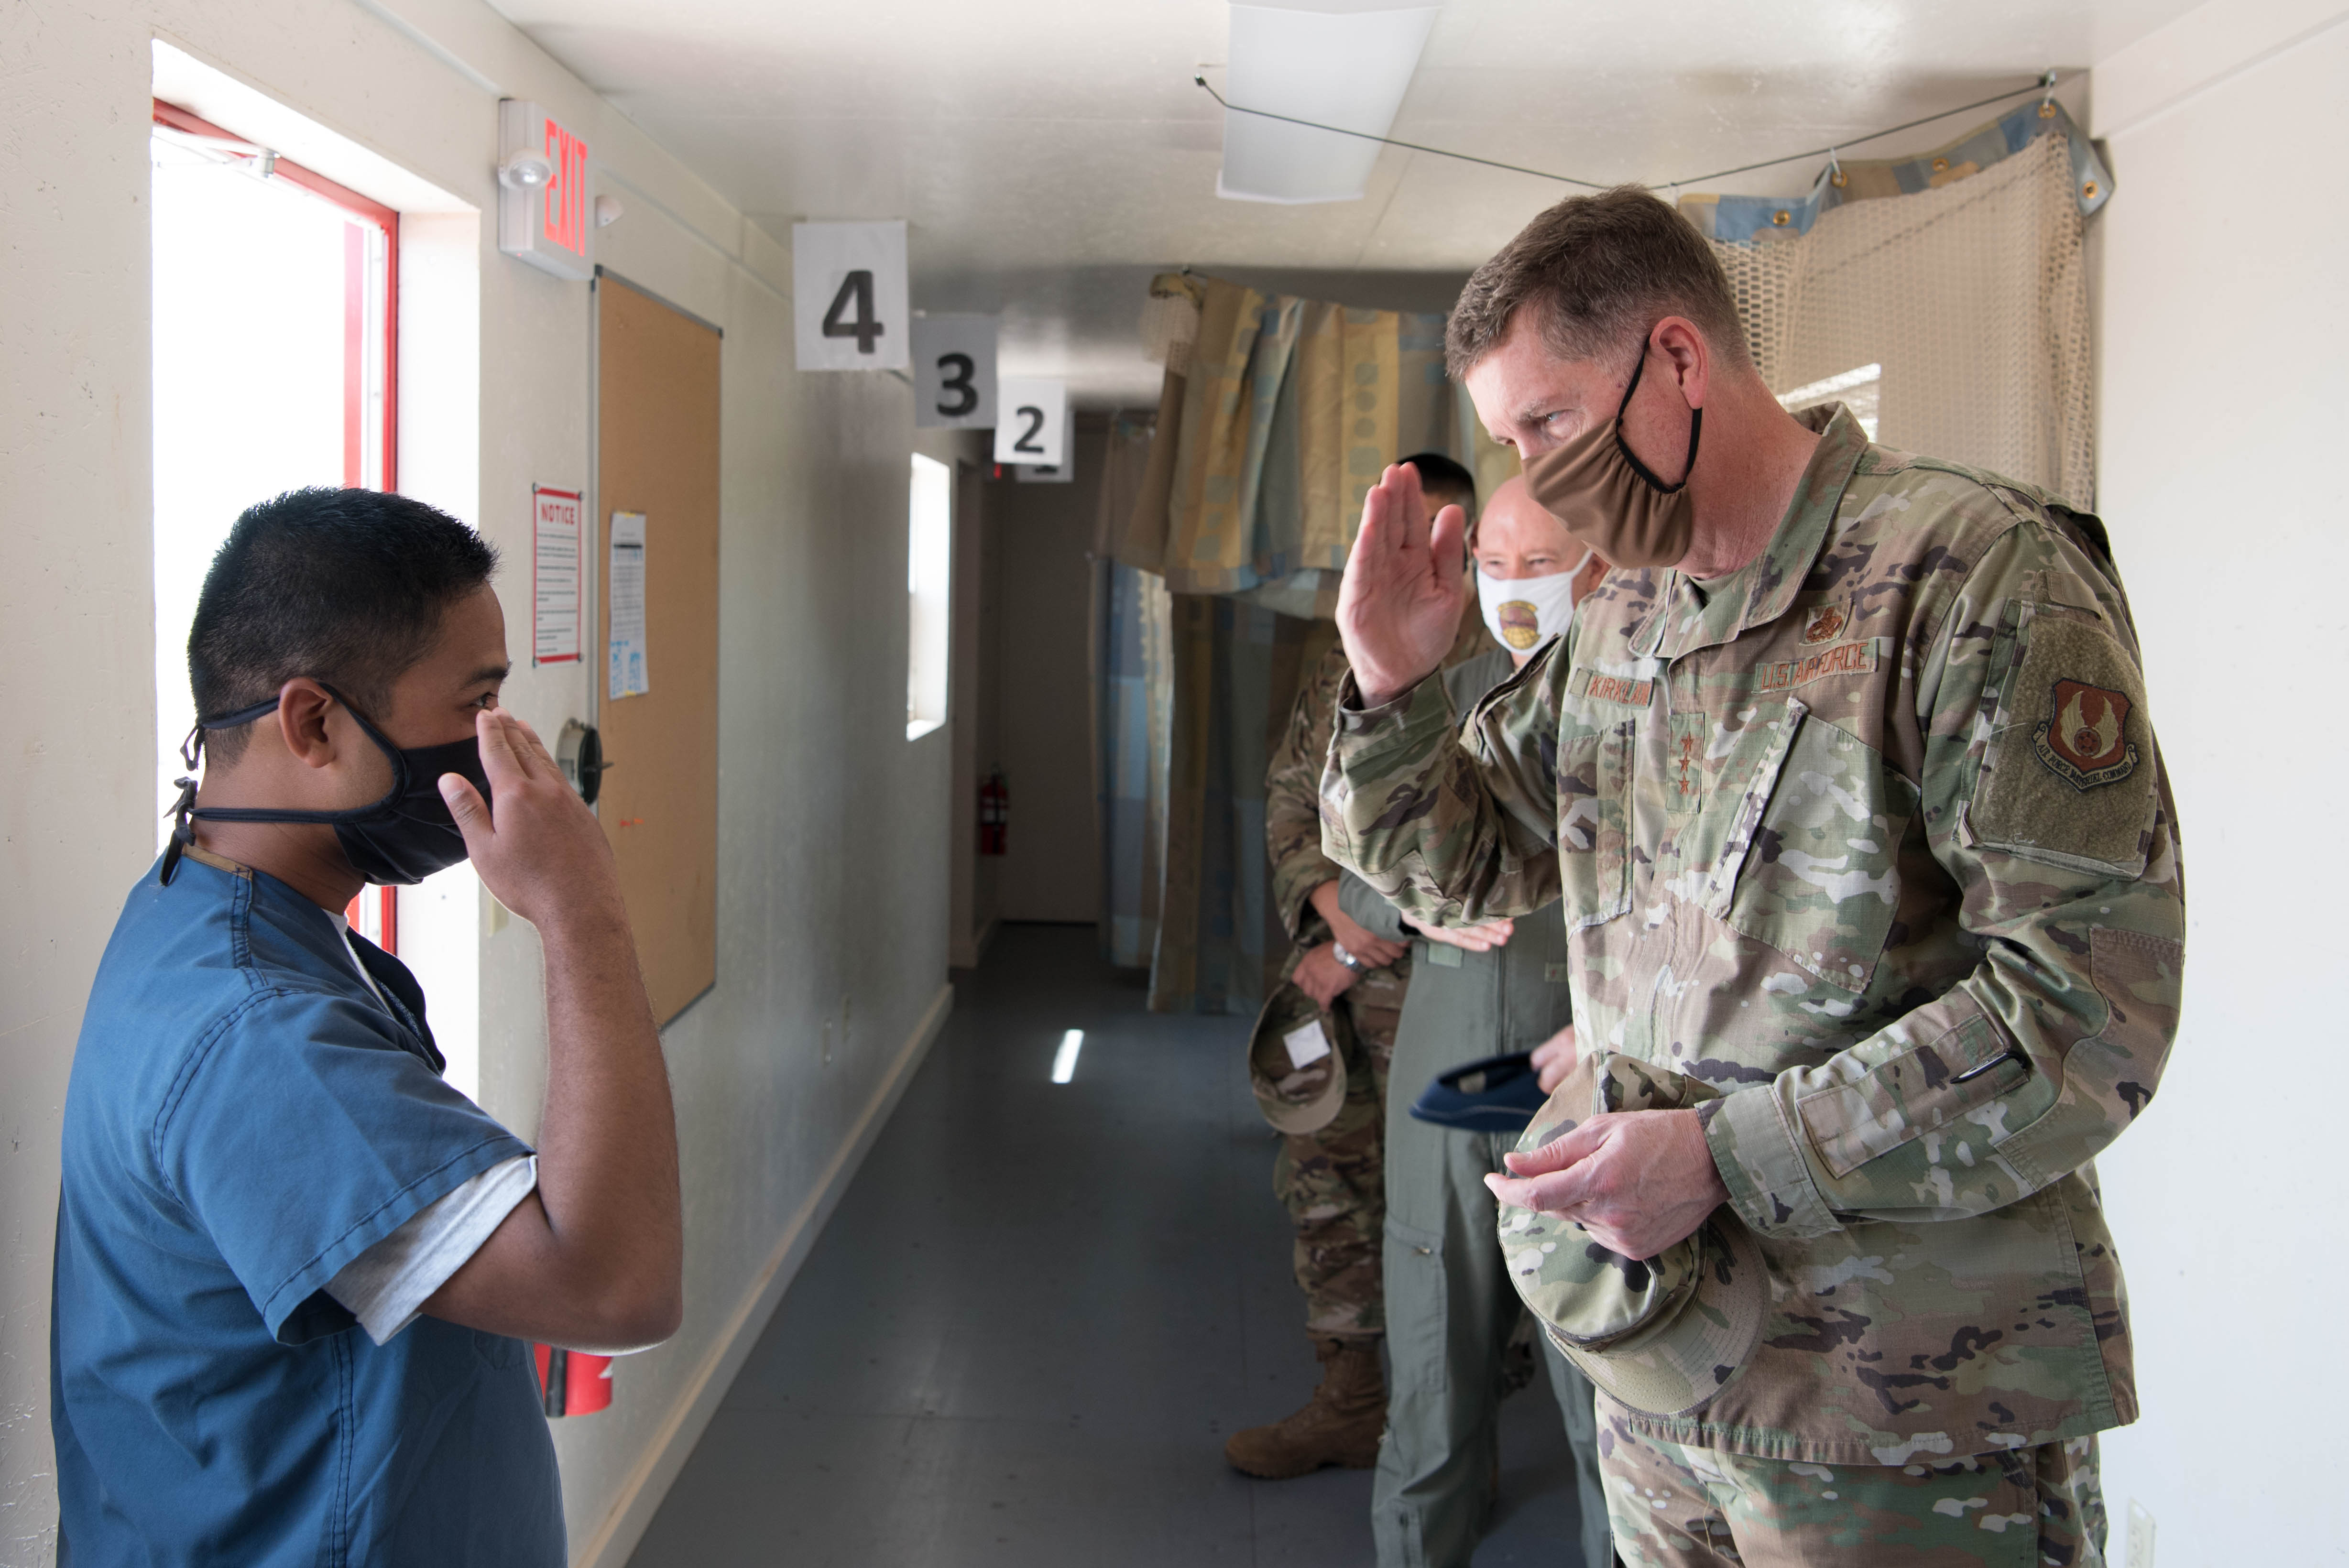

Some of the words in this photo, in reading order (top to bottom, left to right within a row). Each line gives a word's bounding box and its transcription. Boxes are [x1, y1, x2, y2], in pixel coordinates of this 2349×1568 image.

[544, 117, 588, 257] EXIT
[822, 270, 885, 355] 4
[936, 352, 979, 417] 3
[1013, 405, 1045, 454] 2
[540, 502, 575, 526] NOTICE
[1761, 663, 1790, 690] U.S.
[1792, 656, 1819, 685] AIR
[1814, 642, 1868, 677] FORCE
[2037, 744, 2051, 758] AIR
[2047, 755, 2070, 774] FORCE
